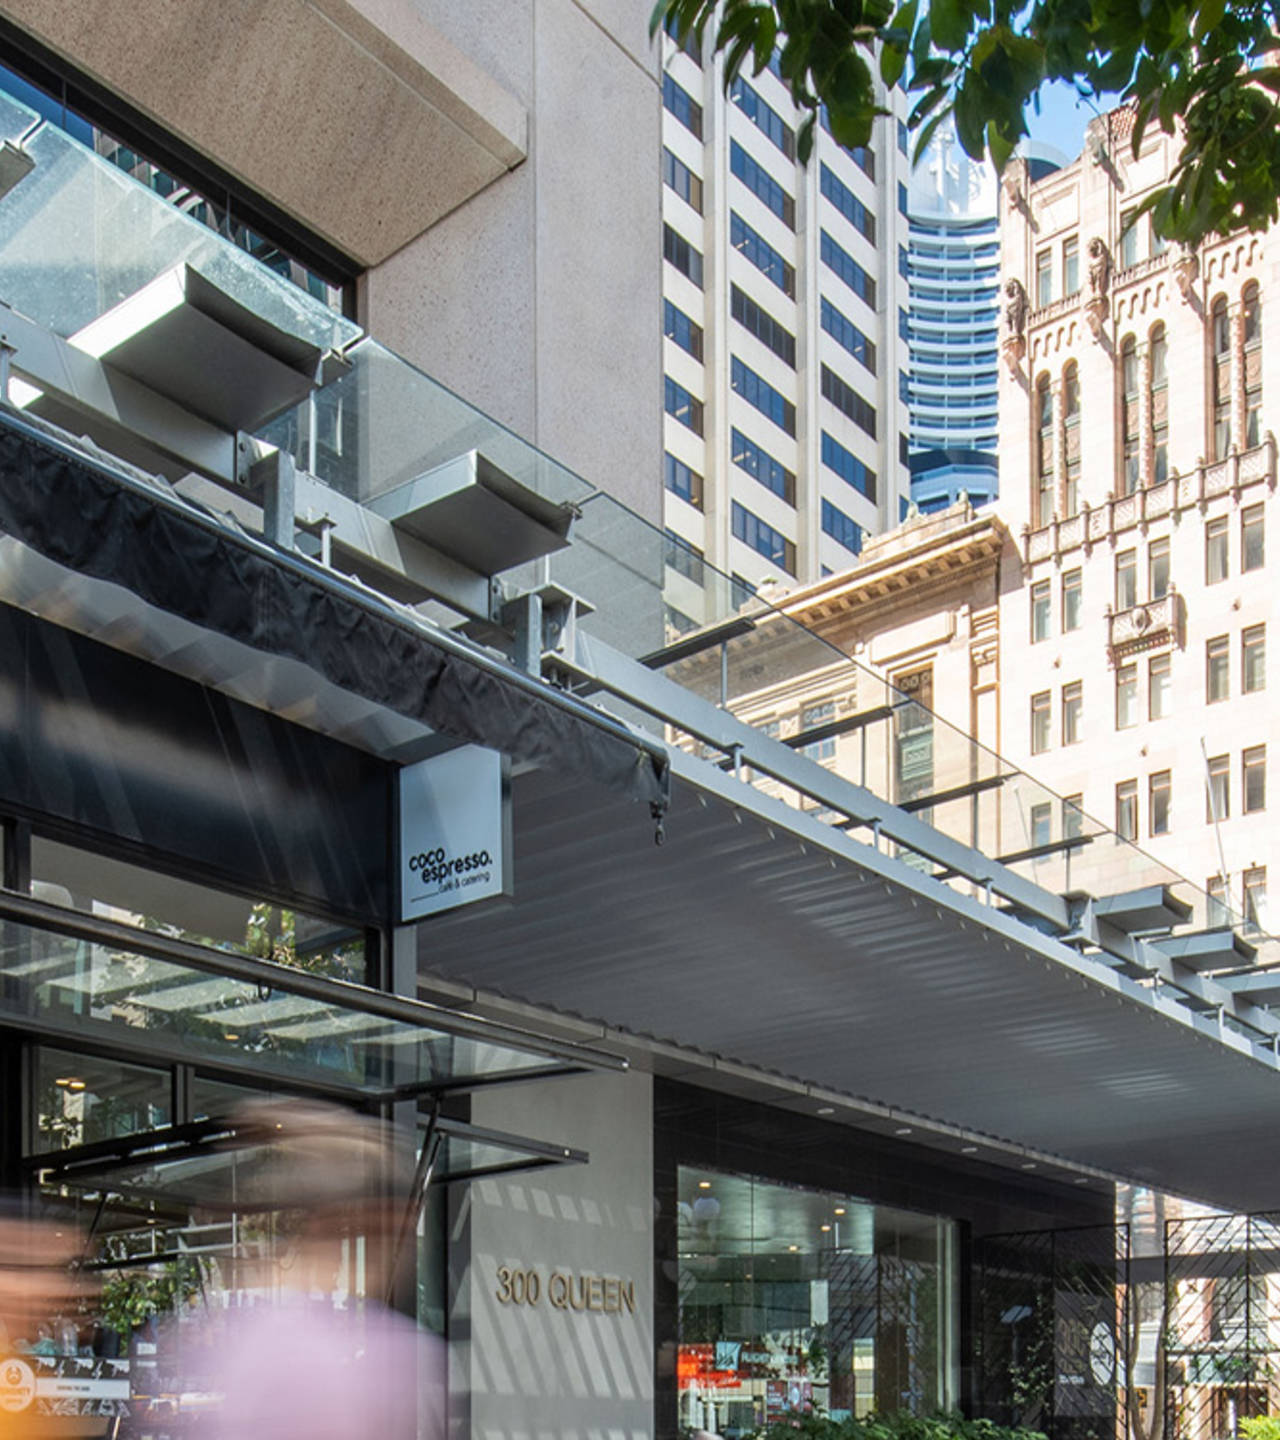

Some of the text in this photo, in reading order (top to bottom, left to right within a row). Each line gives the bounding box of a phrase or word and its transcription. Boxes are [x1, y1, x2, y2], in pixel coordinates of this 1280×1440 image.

[409, 847, 445, 872] coco
[422, 850, 493, 884] espresso.
[495, 1265, 636, 1314] 300 QUEEN
